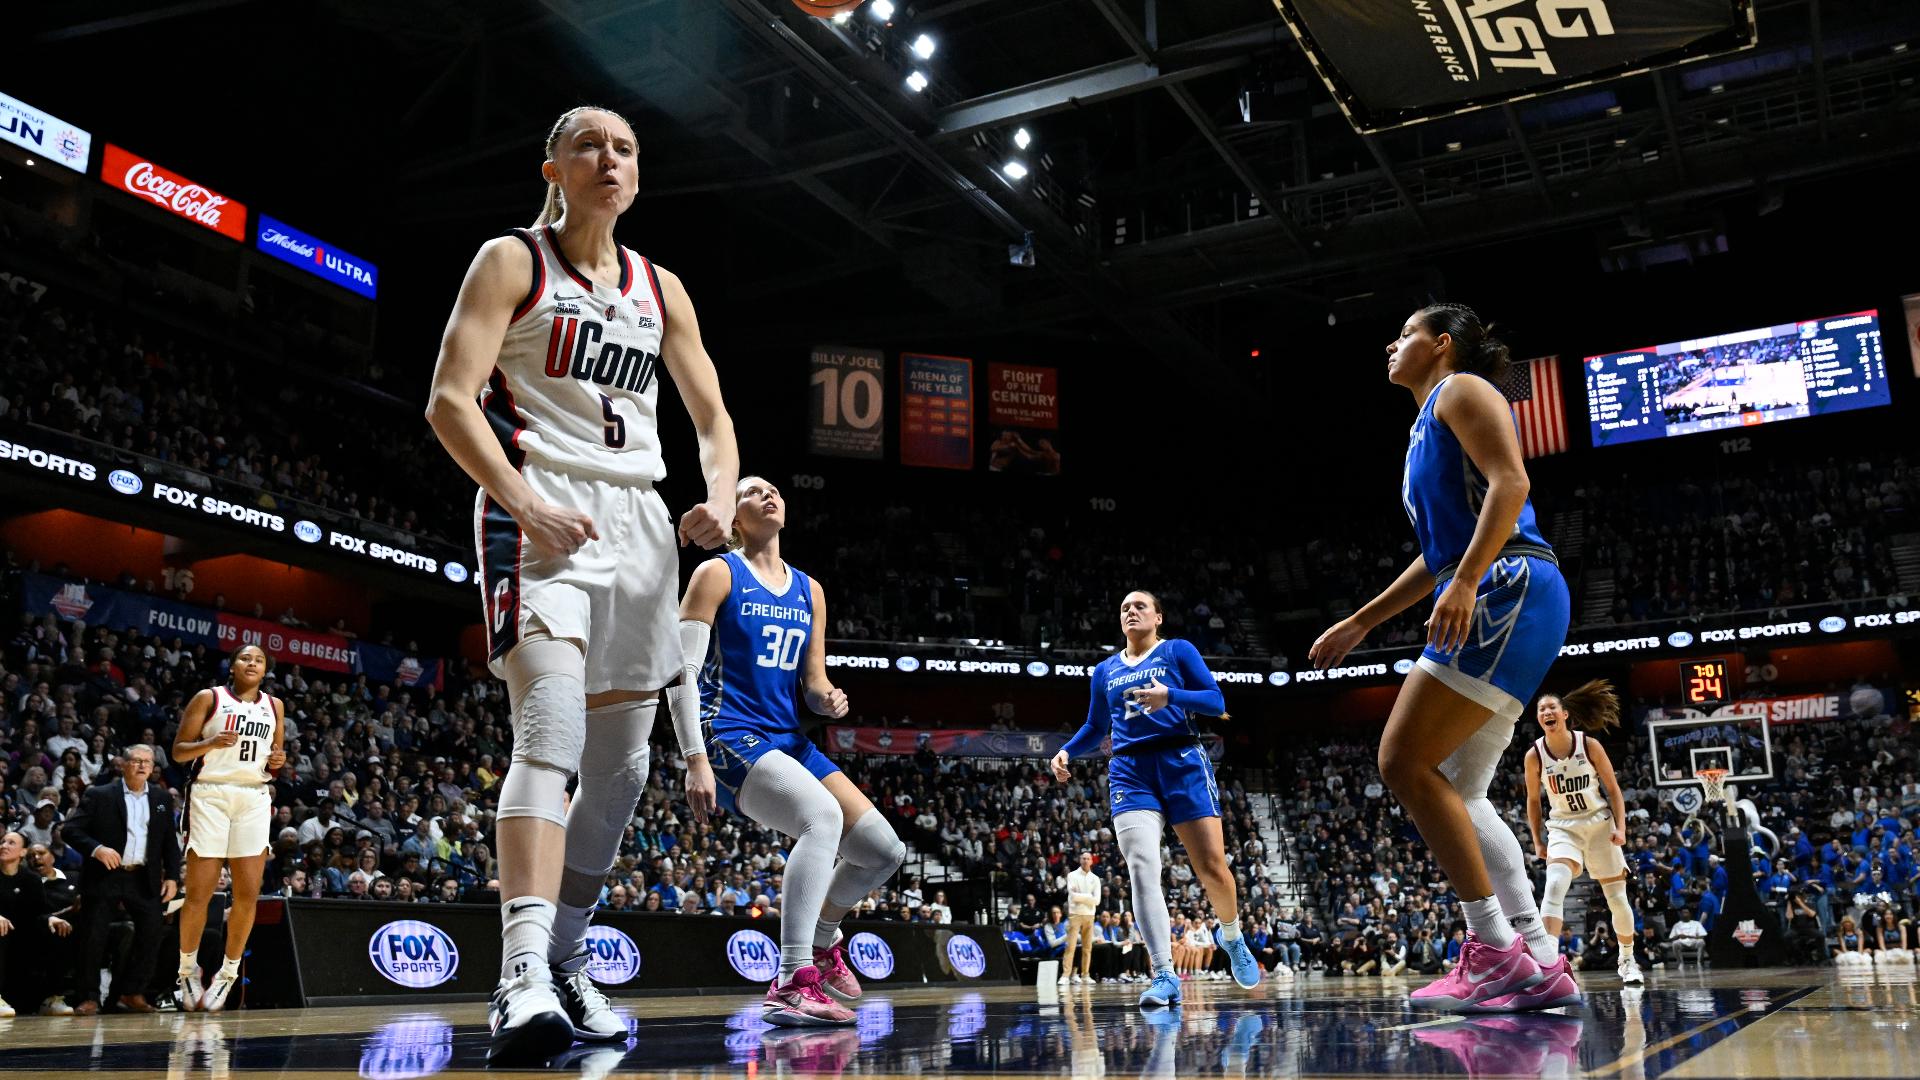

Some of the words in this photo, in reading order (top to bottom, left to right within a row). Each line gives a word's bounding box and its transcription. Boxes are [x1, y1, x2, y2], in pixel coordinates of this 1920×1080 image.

[125, 162, 227, 227] Coca-Cola
[261, 228, 313, 258] Michelob
[325, 254, 374, 286] ULTRA
[556, 306, 581, 315] CHANGE
[545, 316, 656, 394] UConn
[811, 352, 846, 366] BILLY
[848, 355, 882, 369] JOEL
[910, 370, 948, 384] ARENA
[950, 373, 964, 384] OF
[1002, 369, 1044, 384] FIGHT
[1006, 381, 1019, 391] OF
[1022, 383, 1041, 393] THE
[809, 367, 884, 430] 10
[911, 382, 933, 392] THE
[935, 383, 963, 395] YEAR
[991, 390, 1057, 407] CENTURY
[598, 392, 626, 449] 5
[1720, 437, 1752, 454] 112
[116, 474, 135, 486] FOX
[792, 475, 824, 489] 109
[0, 439, 96, 481] SPORTS
[153, 483, 198, 509] FOX
[202, 497, 285, 531] SPORTS
[330, 532, 366, 554] FOX
[369, 543, 438, 573] SPORTS
[1089, 497, 1116, 511] 110
[161, 567, 195, 593] 16
[741, 602, 812, 626] CREIGHTON
[149, 610, 212, 636] FOLLOW
[217, 624, 236, 641] US
[242, 630, 262, 646] ON
[289, 639, 358, 664] @BIGEAST
[1593, 637, 1660, 653] SPORTS
[1701, 628, 1735, 643] FOX
[1738, 622, 1812, 640] SPORTS
[1854, 614, 1892, 628] FOX
[756, 625, 806, 671] 30
[825, 655, 890, 669] SPORTS
[926, 660, 957, 672] FOX
[960, 661, 1021, 674] SPORTS
[1055, 665, 1085, 676] FOX
[1296, 670, 1325, 683] FOX
[1328, 664, 1387, 679] SPORTS
[1107, 667, 1167, 691] CREIGHTON
[1694, 664, 1722, 678] 7:01
[1745, 664, 1778, 683] 20
[1691, 678, 1722, 702] 24
[1123, 683, 1153, 720] 2
[1771, 696, 1840, 722] SHINE
[225, 714, 271, 739] UConn
[239, 740, 257, 762] 21
[1548, 774, 1590, 794] UConn
[1566, 793, 1588, 812] 20
[387, 934, 435, 961] FOX
[586, 938, 626, 961] FOX
[738, 941, 770, 961] FOX
[857, 943, 884, 961] FOX
[954, 943, 977, 960] FOX
[392, 961, 443, 973] SPORTS
[743, 962, 772, 970] SPORTS
